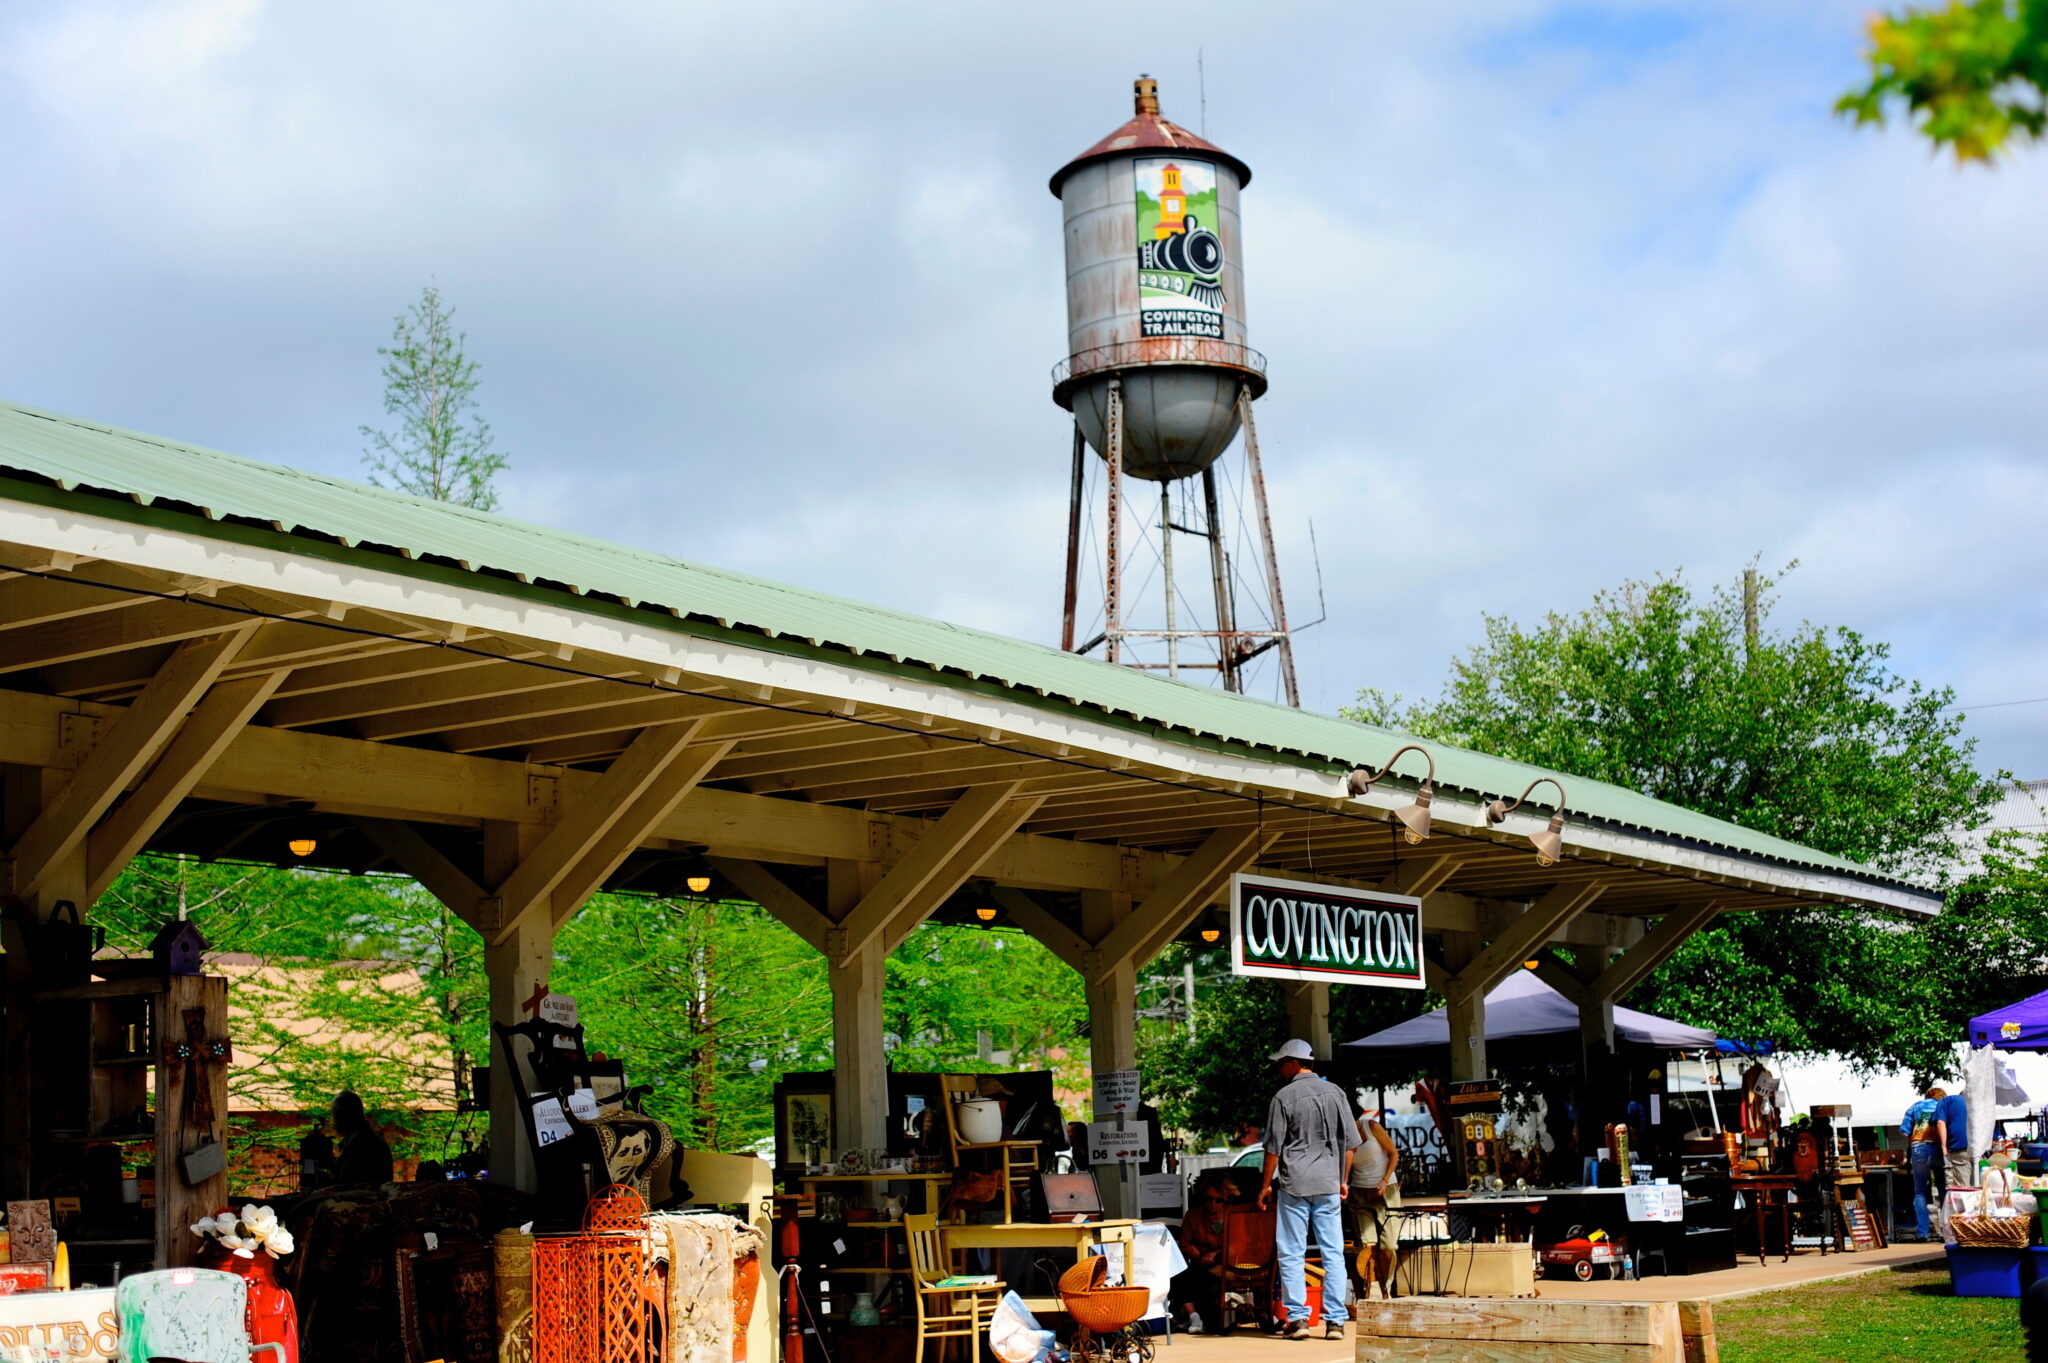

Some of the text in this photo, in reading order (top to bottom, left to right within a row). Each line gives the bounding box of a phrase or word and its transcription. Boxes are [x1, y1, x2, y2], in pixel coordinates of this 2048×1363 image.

[1143, 311, 1220, 325] COVINGTON
[1144, 323, 1221, 337] TRAILHEAD
[1246, 895, 1415, 969] COVINGTON
[541, 1130, 557, 1144] D4
[1092, 1149, 1108, 1160] D6
